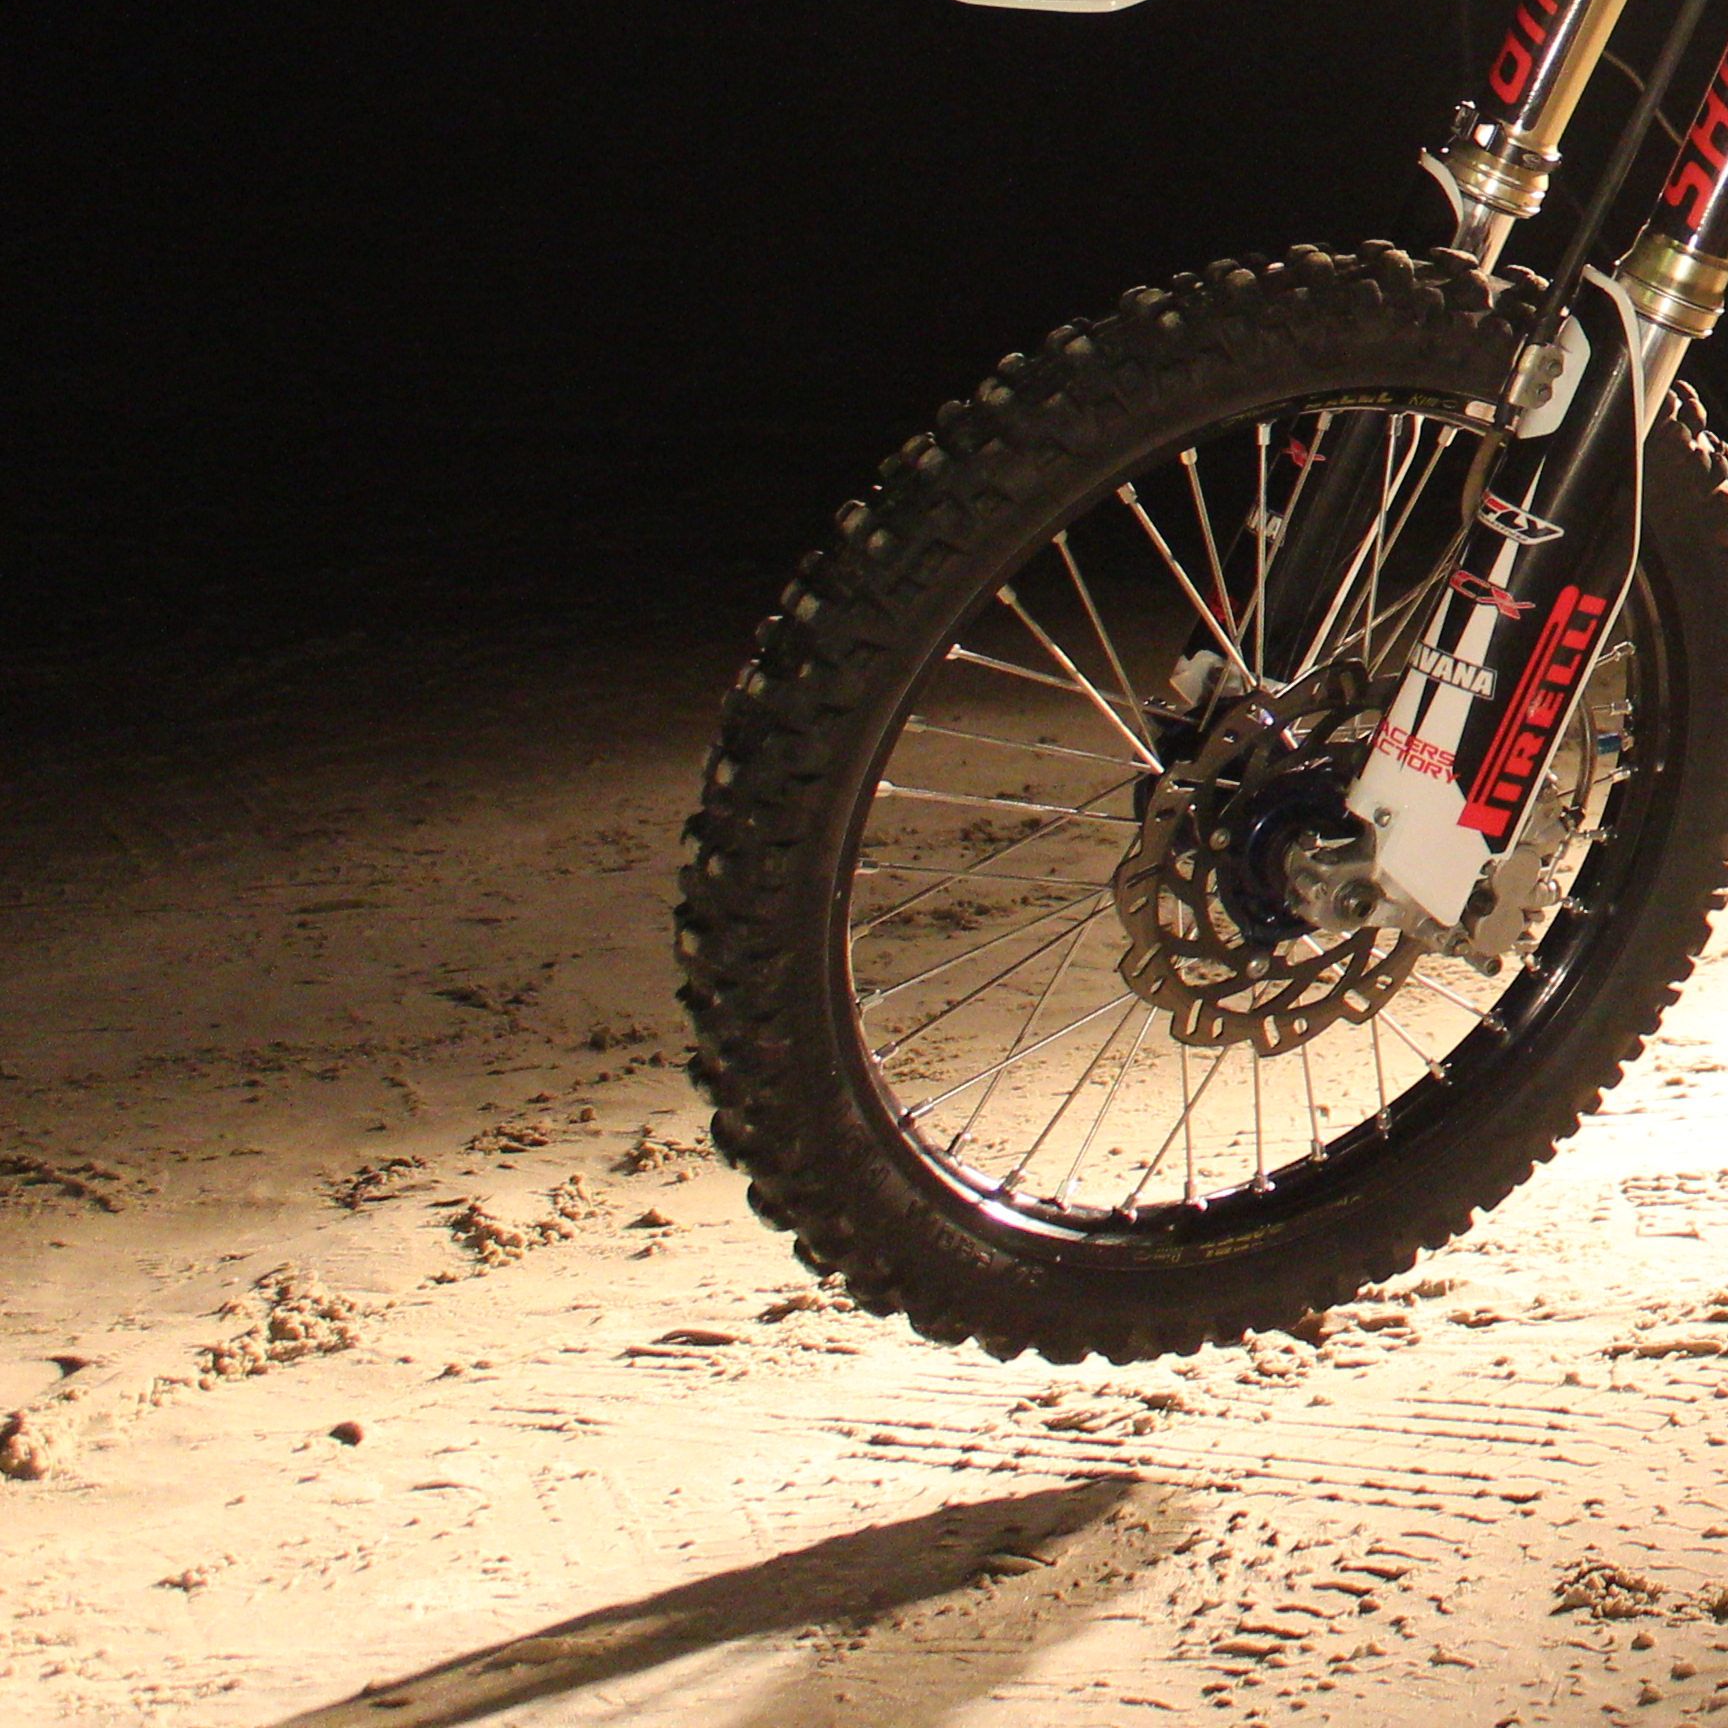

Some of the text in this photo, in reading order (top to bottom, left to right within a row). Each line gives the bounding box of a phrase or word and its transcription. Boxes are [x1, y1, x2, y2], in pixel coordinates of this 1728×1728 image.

[1410, 642, 1494, 696] AVANA
[1457, 584, 1608, 838] PIRELLI
[1373, 737, 1462, 784] CTORY
[1379, 718, 1456, 767] ACERS
